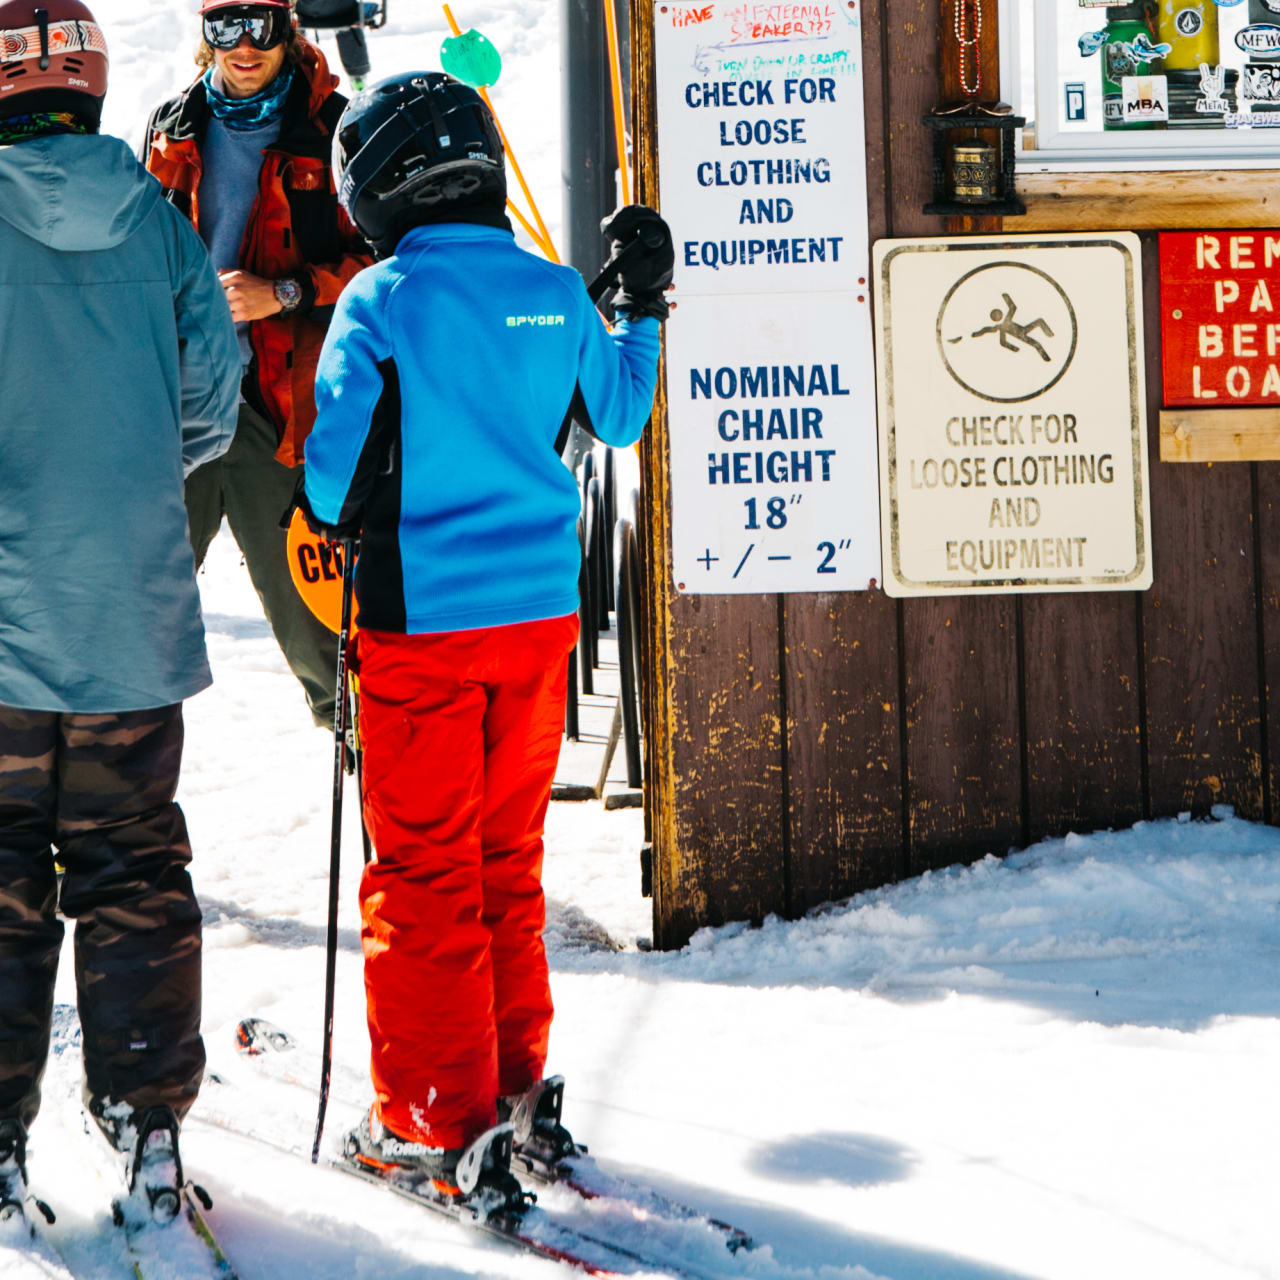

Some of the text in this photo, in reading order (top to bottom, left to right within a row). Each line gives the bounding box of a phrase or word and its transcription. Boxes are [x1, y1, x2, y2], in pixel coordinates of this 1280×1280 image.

[68, 78, 89, 88] SMITH
[685, 78, 836, 108] CHECK FOR
[1128, 99, 1164, 113] MBA
[719, 118, 806, 146] LOOSE
[468, 151, 488, 160] SMITH
[697, 157, 831, 186] CLOTHING
[739, 198, 794, 224] AND
[684, 236, 843, 270] EQUIPMENT
[506, 315, 565, 327] SPYDER
[690, 363, 850, 400] NOMINAL
[718, 407, 824, 442] CHAIR
[945, 413, 1078, 447] CHECK FOR
[708, 450, 836, 485] HEIGHT
[909, 454, 1114, 490] LOOSE CLOTHING
[744, 494, 802, 530] 18"
[988, 497, 1041, 528] AND
[945, 537, 1087, 574] EQUIPMENT
